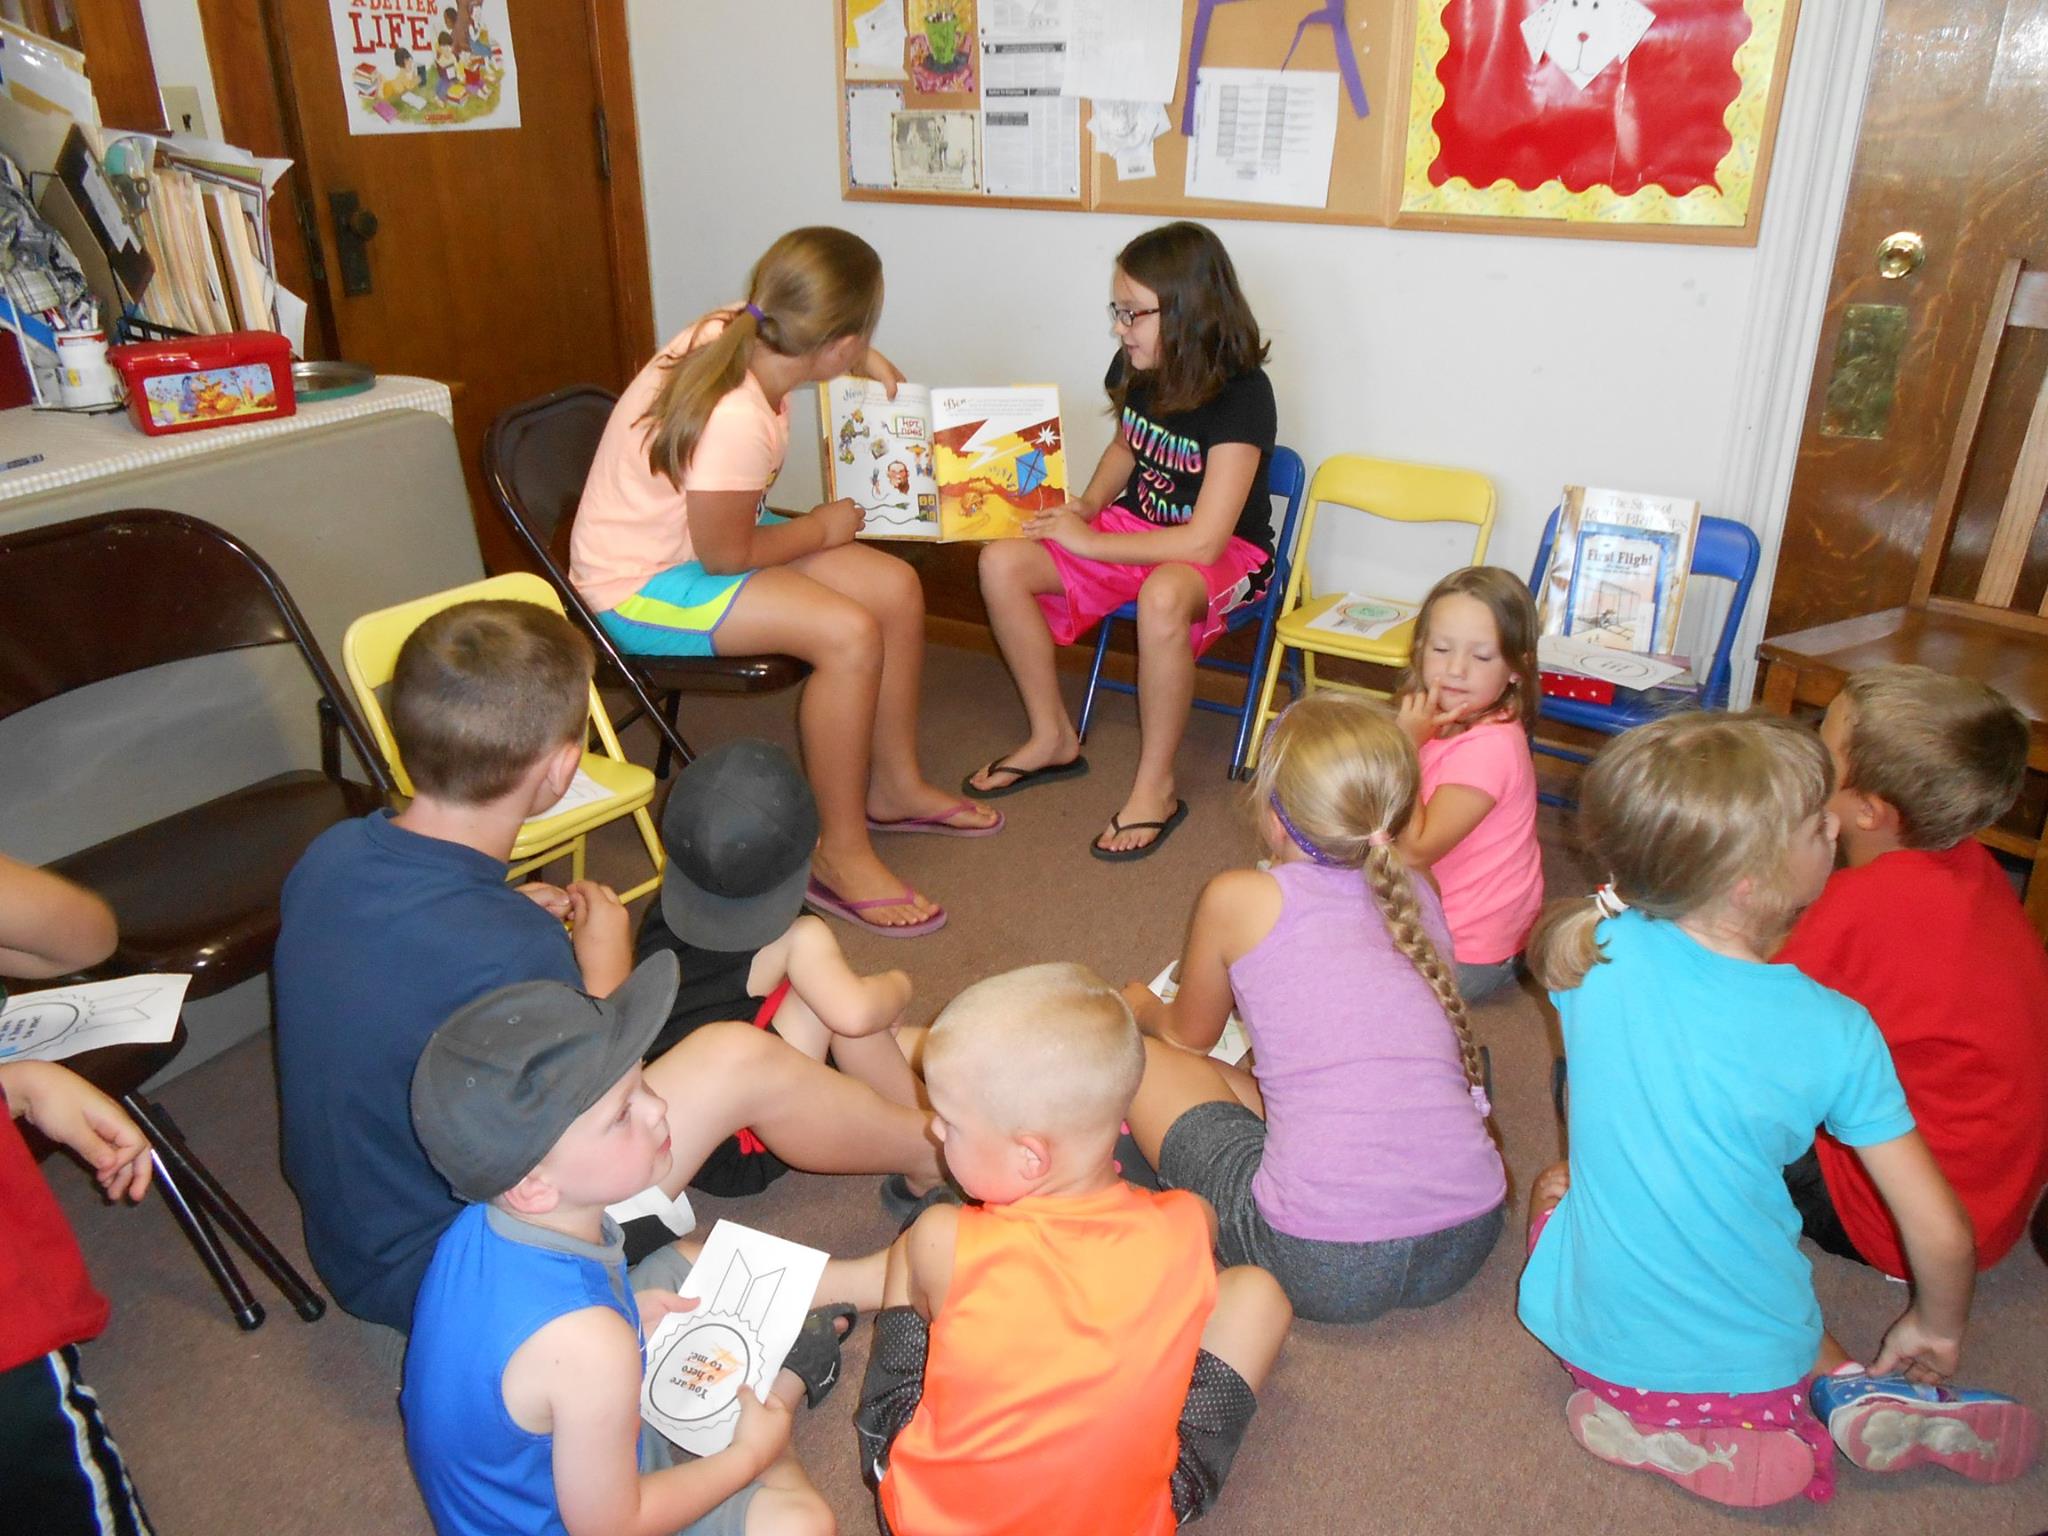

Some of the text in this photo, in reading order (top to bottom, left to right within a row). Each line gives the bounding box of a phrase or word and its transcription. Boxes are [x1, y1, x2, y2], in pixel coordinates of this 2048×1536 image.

[348, 12, 433, 54] LIFE
[1617, 552, 1654, 568] Flight
[681, 1364, 715, 1383] a hero
[709, 1359, 722, 1372] to
[669, 1376, 708, 1400] You are
